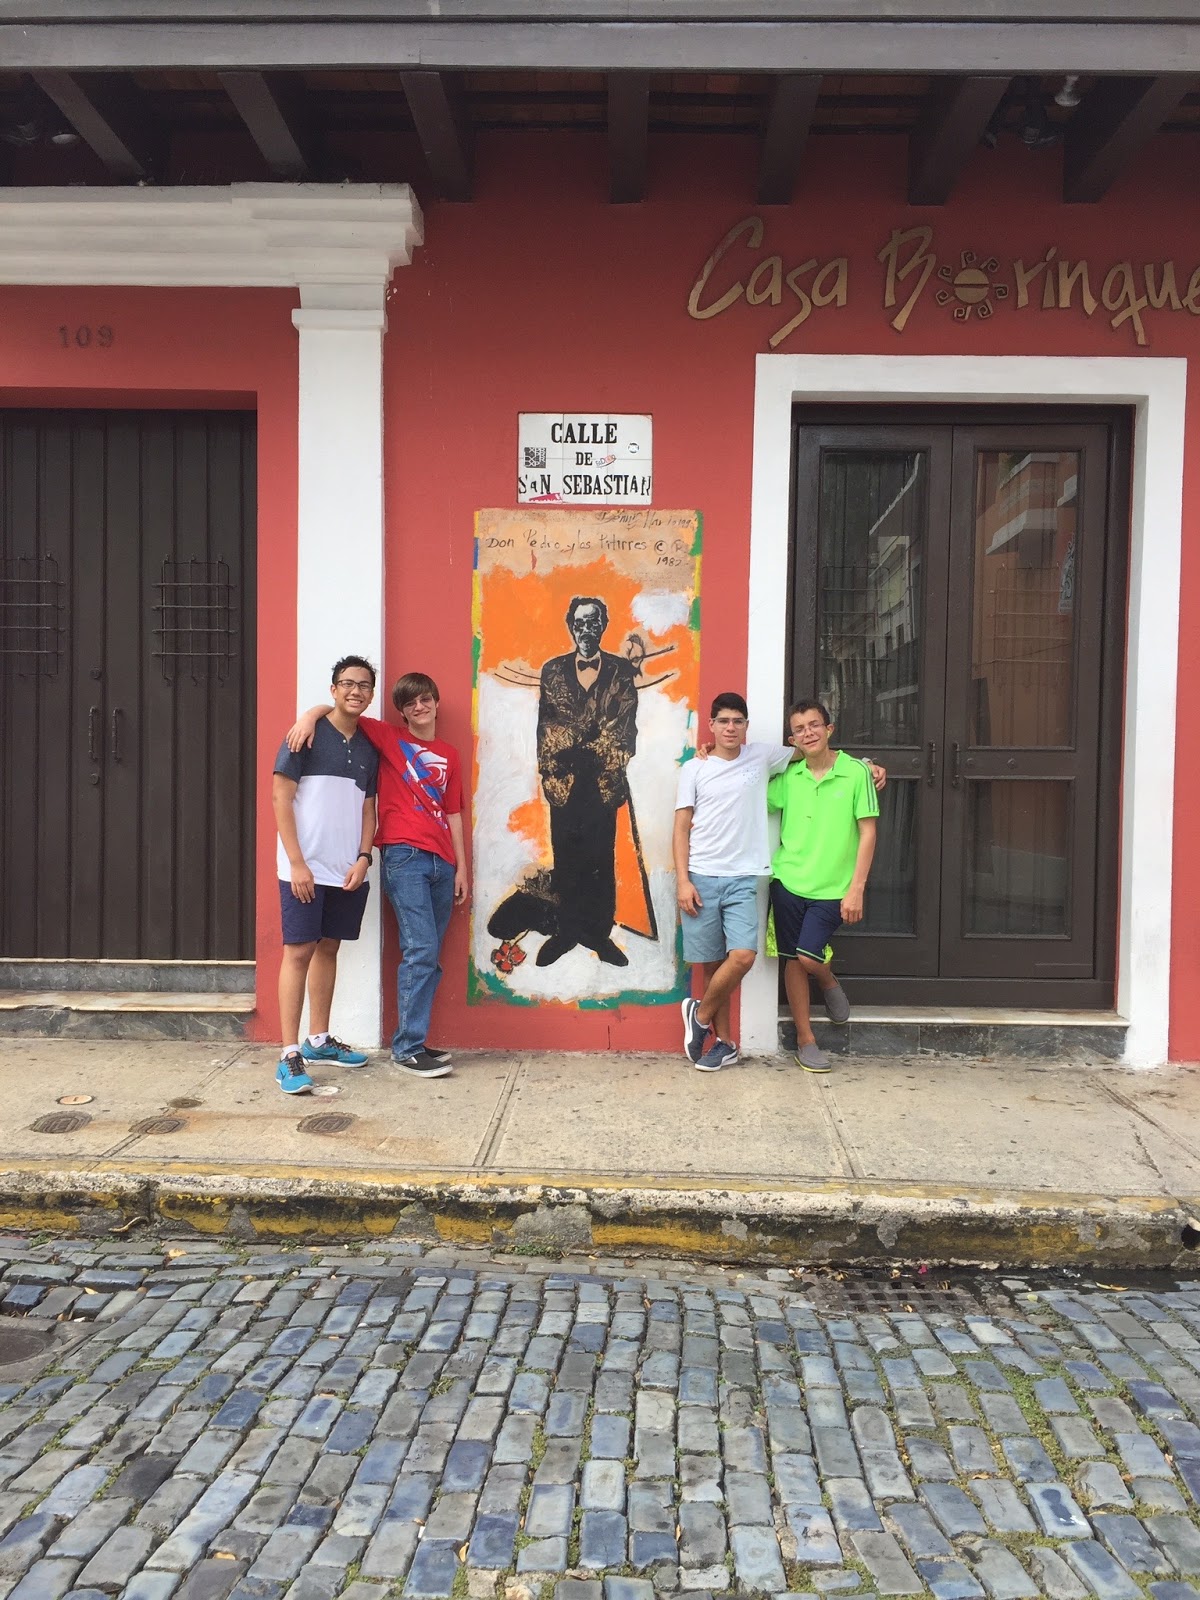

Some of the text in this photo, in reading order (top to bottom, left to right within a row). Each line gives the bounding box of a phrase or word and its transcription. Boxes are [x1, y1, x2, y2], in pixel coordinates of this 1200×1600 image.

[687, 216, 848, 350] Casa
[59, 324, 114, 348] 109
[551, 423, 618, 444] CALLE
[575, 452, 593, 466] DE
[485, 537, 515, 548] Don
